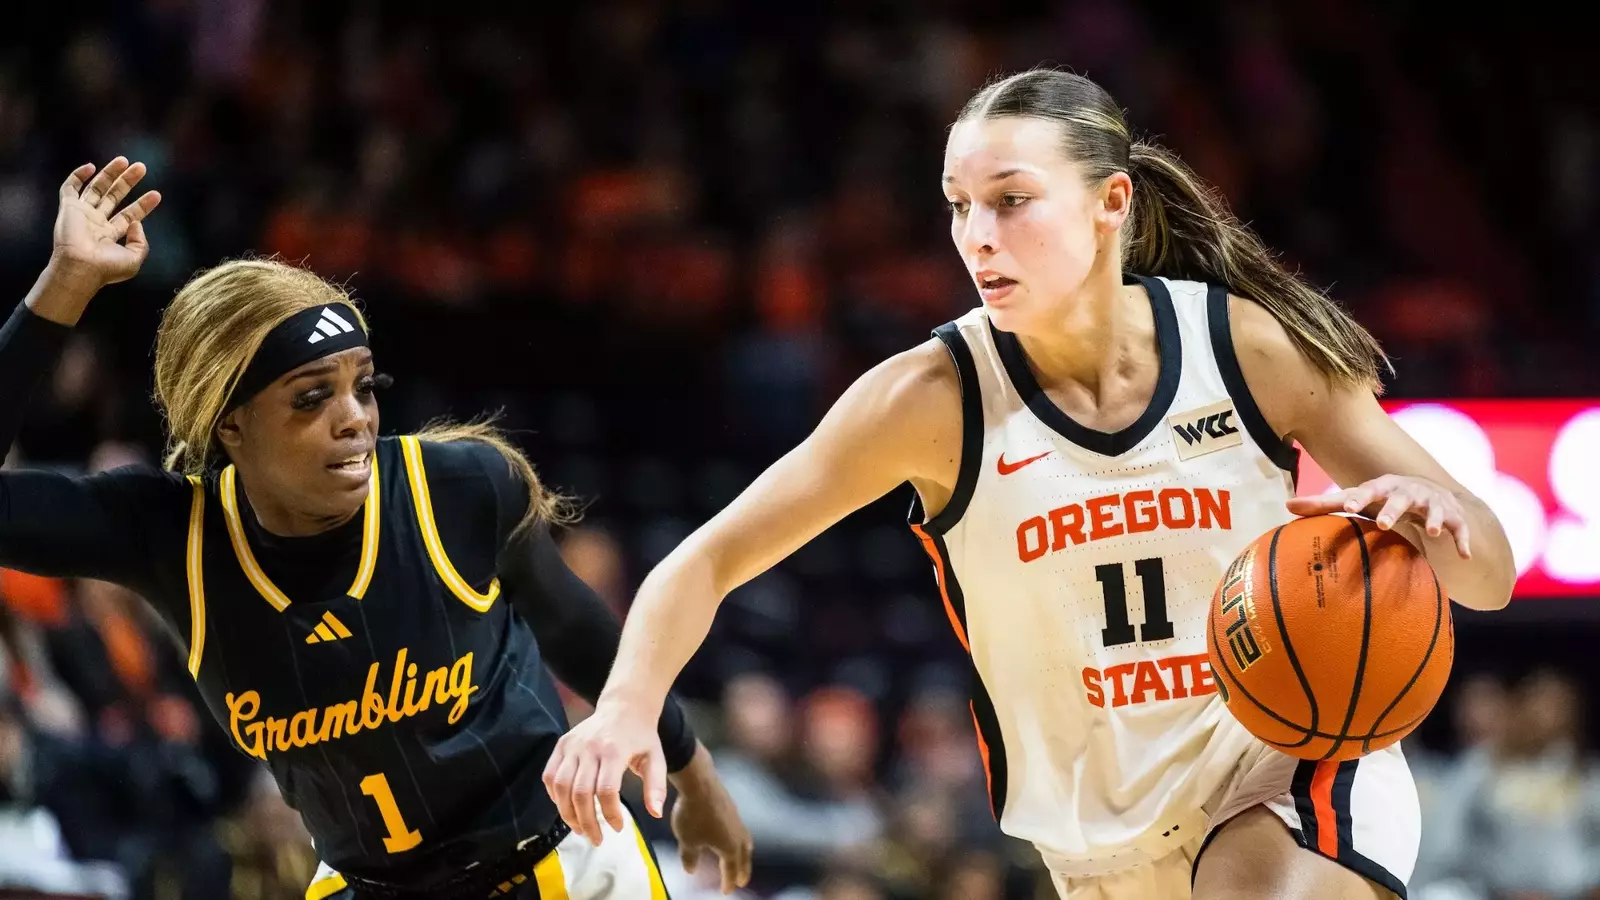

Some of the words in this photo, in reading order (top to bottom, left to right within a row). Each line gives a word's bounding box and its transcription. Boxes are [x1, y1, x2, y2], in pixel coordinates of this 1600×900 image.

[1173, 409, 1239, 447] WCC
[1016, 488, 1232, 563] OREGON
[1095, 557, 1175, 647] 11
[1221, 548, 1263, 673] ELITE
[225, 648, 479, 761] Grambling
[1082, 653, 1219, 708] STATE
[359, 772, 423, 854] 1
